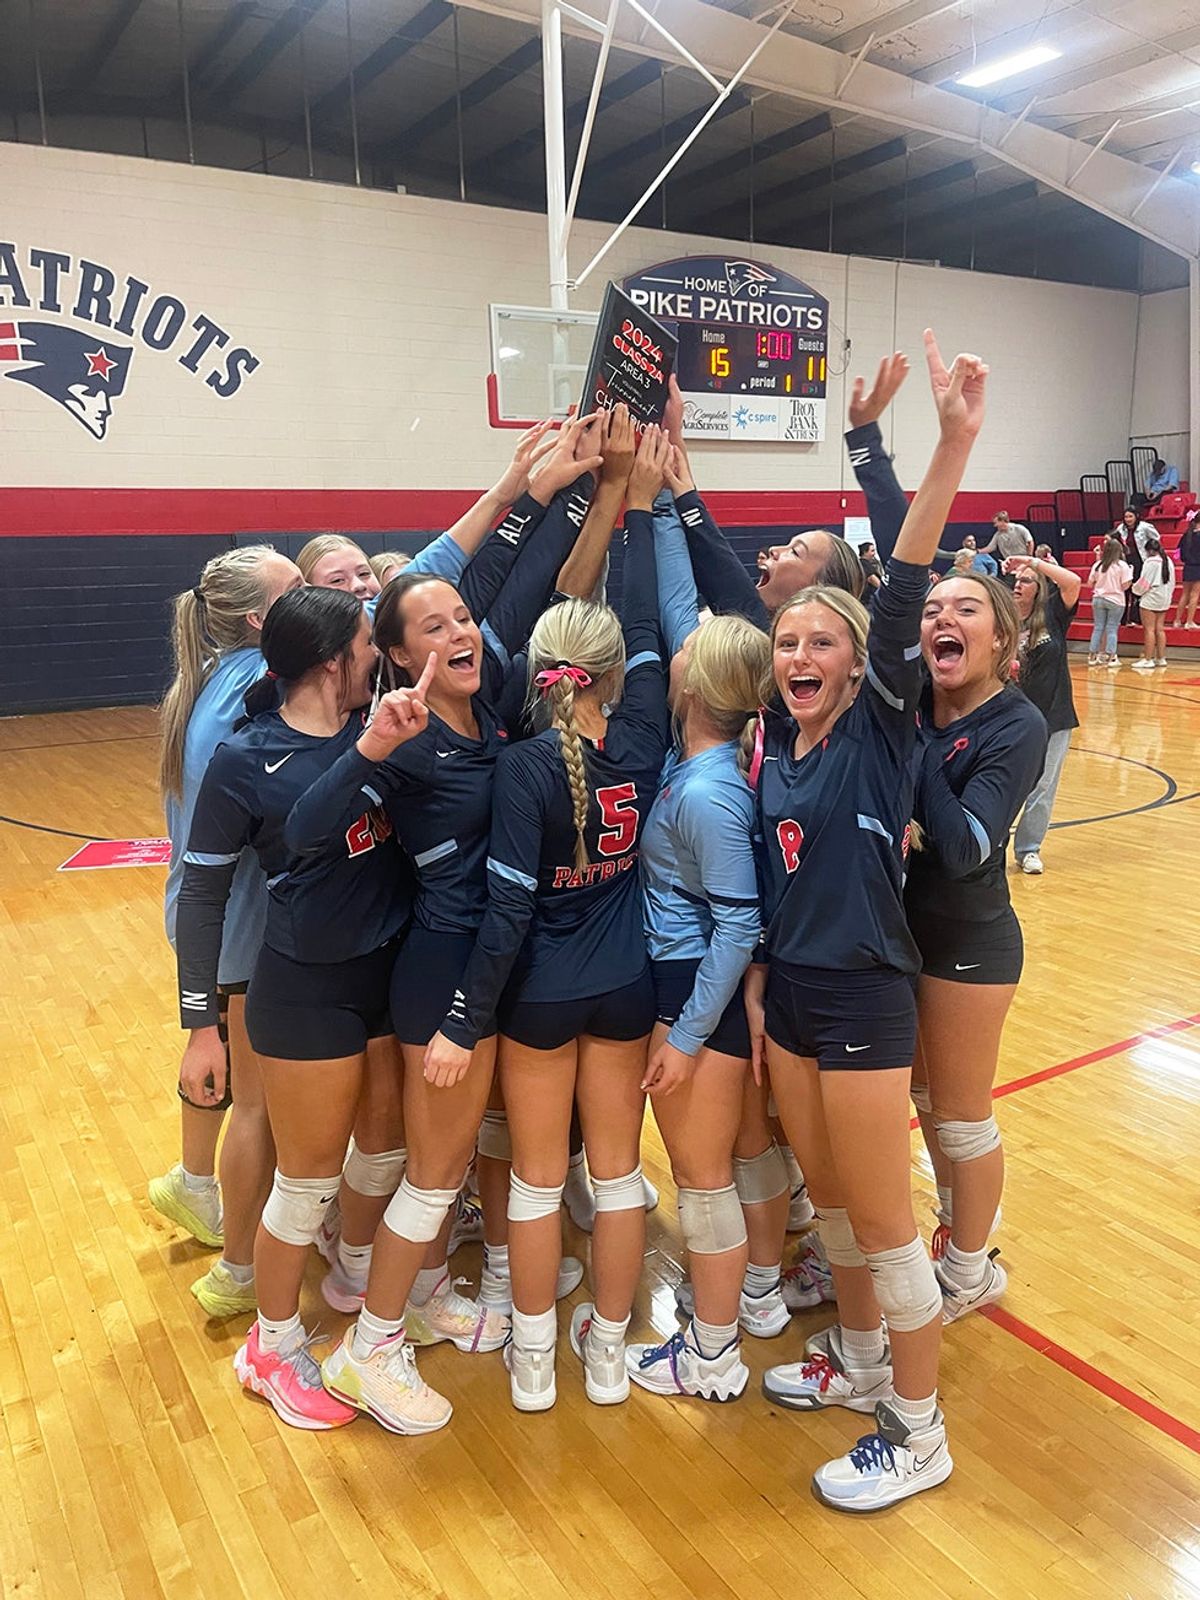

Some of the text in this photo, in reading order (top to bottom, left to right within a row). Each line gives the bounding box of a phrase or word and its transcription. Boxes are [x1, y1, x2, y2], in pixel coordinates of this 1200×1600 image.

[684, 276, 768, 297] HOME OF
[630, 289, 823, 330] PIKE PATRIOTS
[622, 319, 664, 362] 2024
[702, 329, 726, 344] Home
[757, 331, 792, 360] 1:00
[797, 338, 824, 352] Guests
[613, 335, 665, 384] CLASS 2A
[711, 348, 730, 377] 15
[808, 355, 825, 381] 11
[620, 360, 645, 385] AREA
[643, 377, 651, 389] 3
[750, 374, 792, 393] period 1
[693, 408, 728, 423] Complete
[790, 399, 816, 416] TROY
[790, 416, 818, 430] BANK
[567, 492, 590, 528] ALL
[496, 512, 532, 546] ALL
[595, 782, 639, 857] 5
